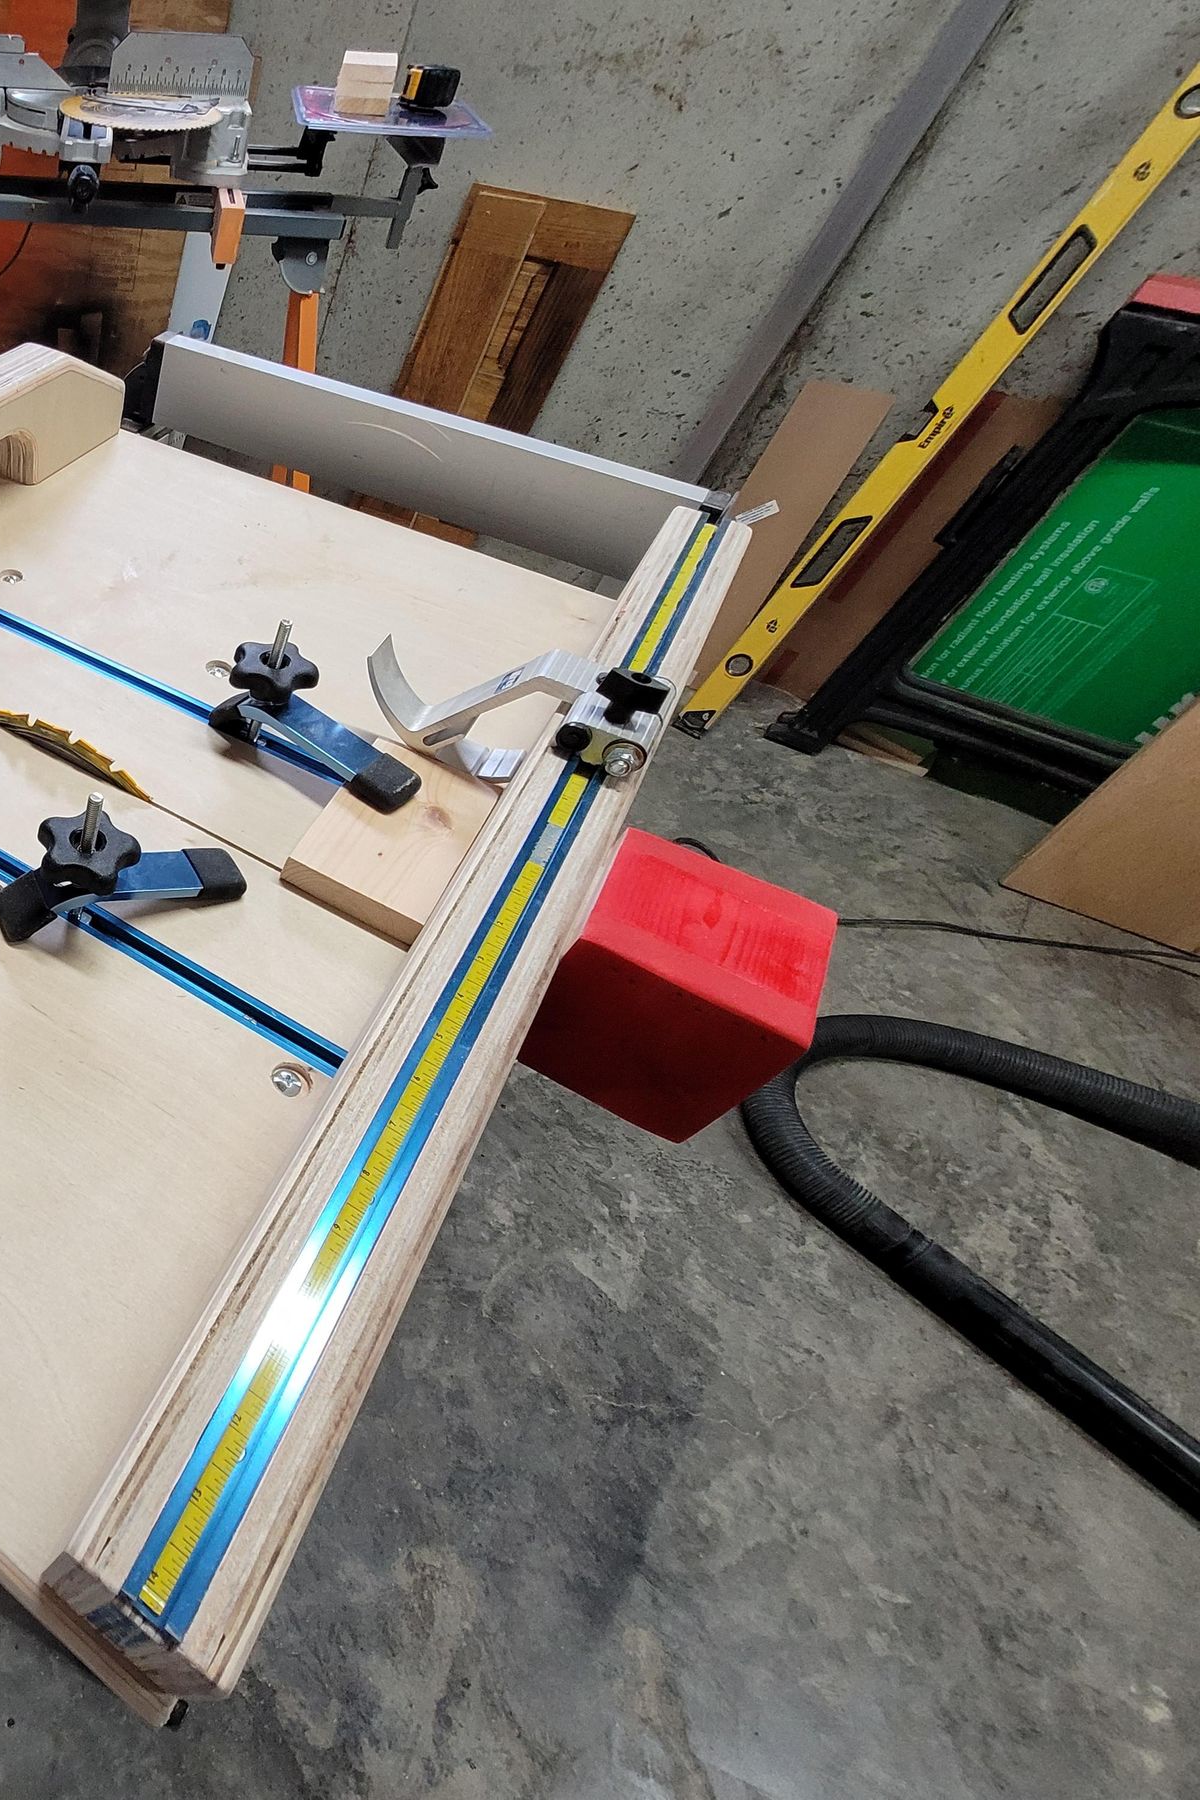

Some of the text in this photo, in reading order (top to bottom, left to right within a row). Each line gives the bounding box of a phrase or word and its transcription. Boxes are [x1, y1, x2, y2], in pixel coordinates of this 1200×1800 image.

[936, 649, 952, 661] for
[949, 619, 979, 649] radiant
[976, 597, 999, 618] floor
[996, 562, 1034, 596] heating
[1030, 521, 1071, 560] systems
[947, 668, 958, 678] or
[956, 635, 989, 668] exterior
[986, 588, 1035, 635] foundation
[1032, 567, 1054, 587] wall
[1050, 520, 1099, 567] insulation
[980, 625, 1025, 667] insulation
[1020, 611, 1037, 625] for
[1036, 576, 1072, 611] exterior
[1071, 545, 1102, 574] above
[1100, 515, 1132, 544] grade
[1128, 487, 1160, 513] walls
[231, 1413, 242, 1426] 12
[191, 1488, 202, 1501] 13
[147, 1571, 158, 1585] 14
